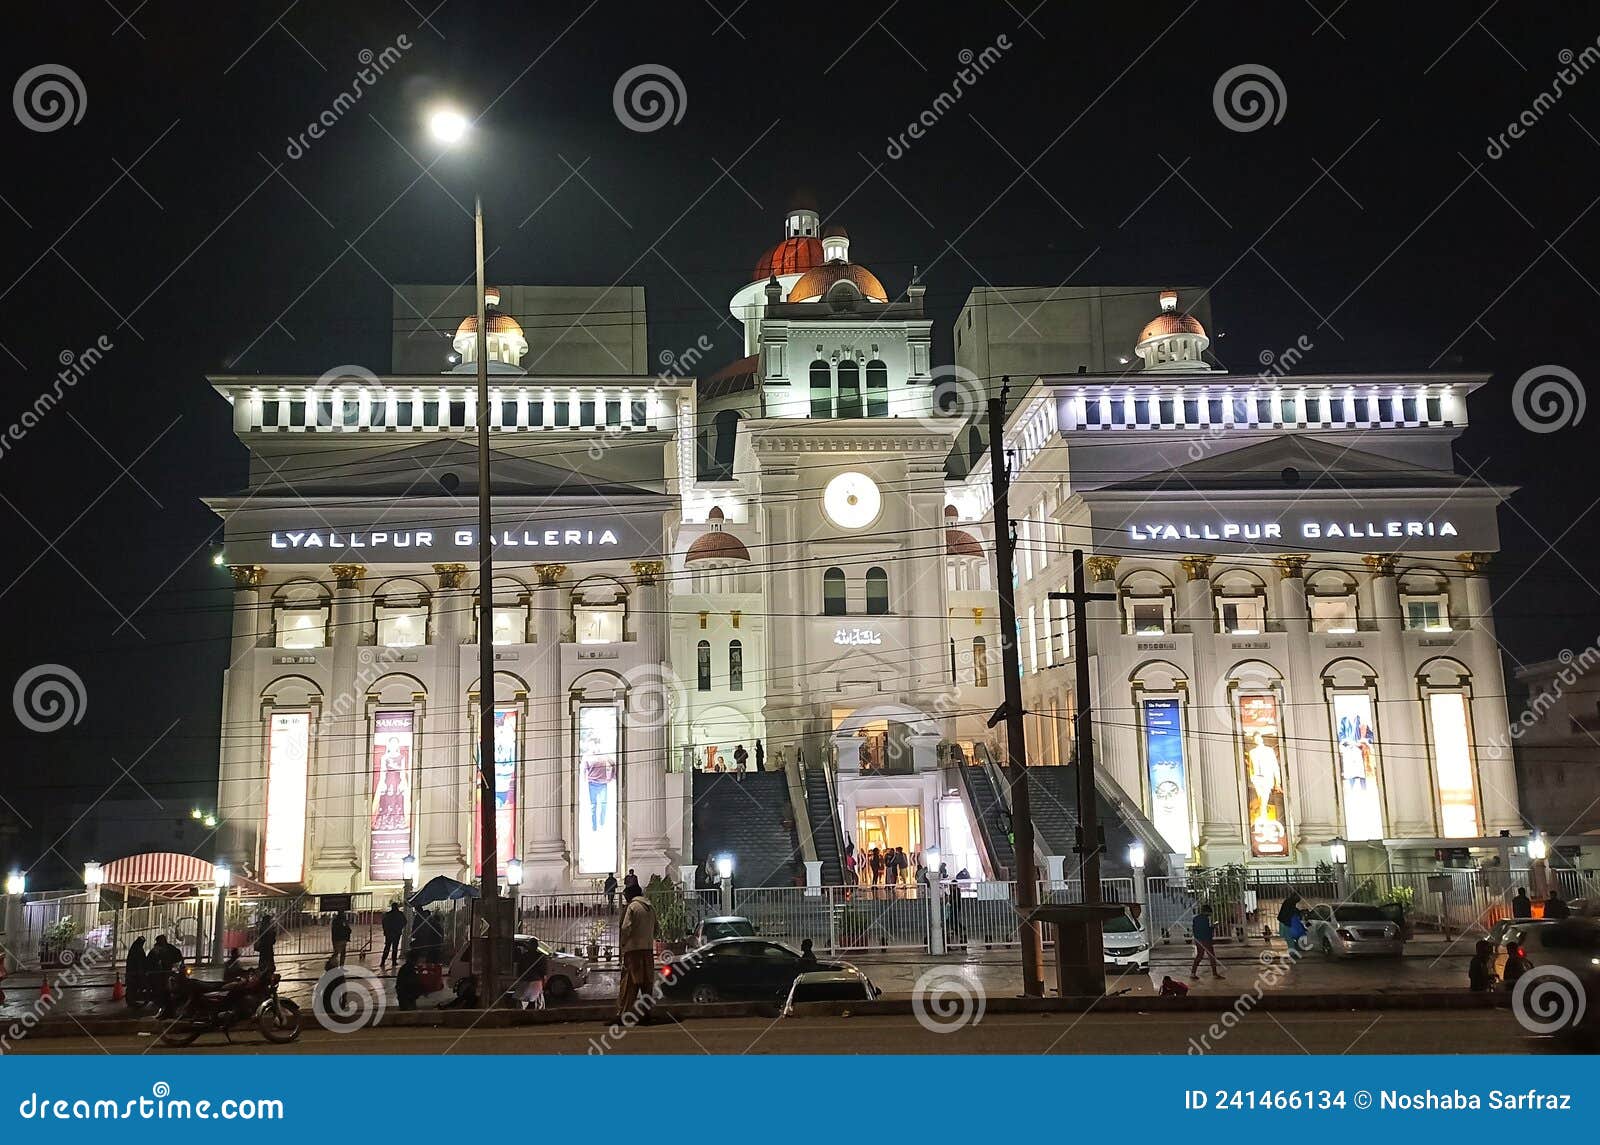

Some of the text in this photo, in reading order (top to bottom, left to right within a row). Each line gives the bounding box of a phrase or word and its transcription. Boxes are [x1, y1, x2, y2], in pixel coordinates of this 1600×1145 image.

[1132, 523, 1457, 539] LYALLPUR GALLERIA
[272, 532, 432, 547] LYALLPUR
